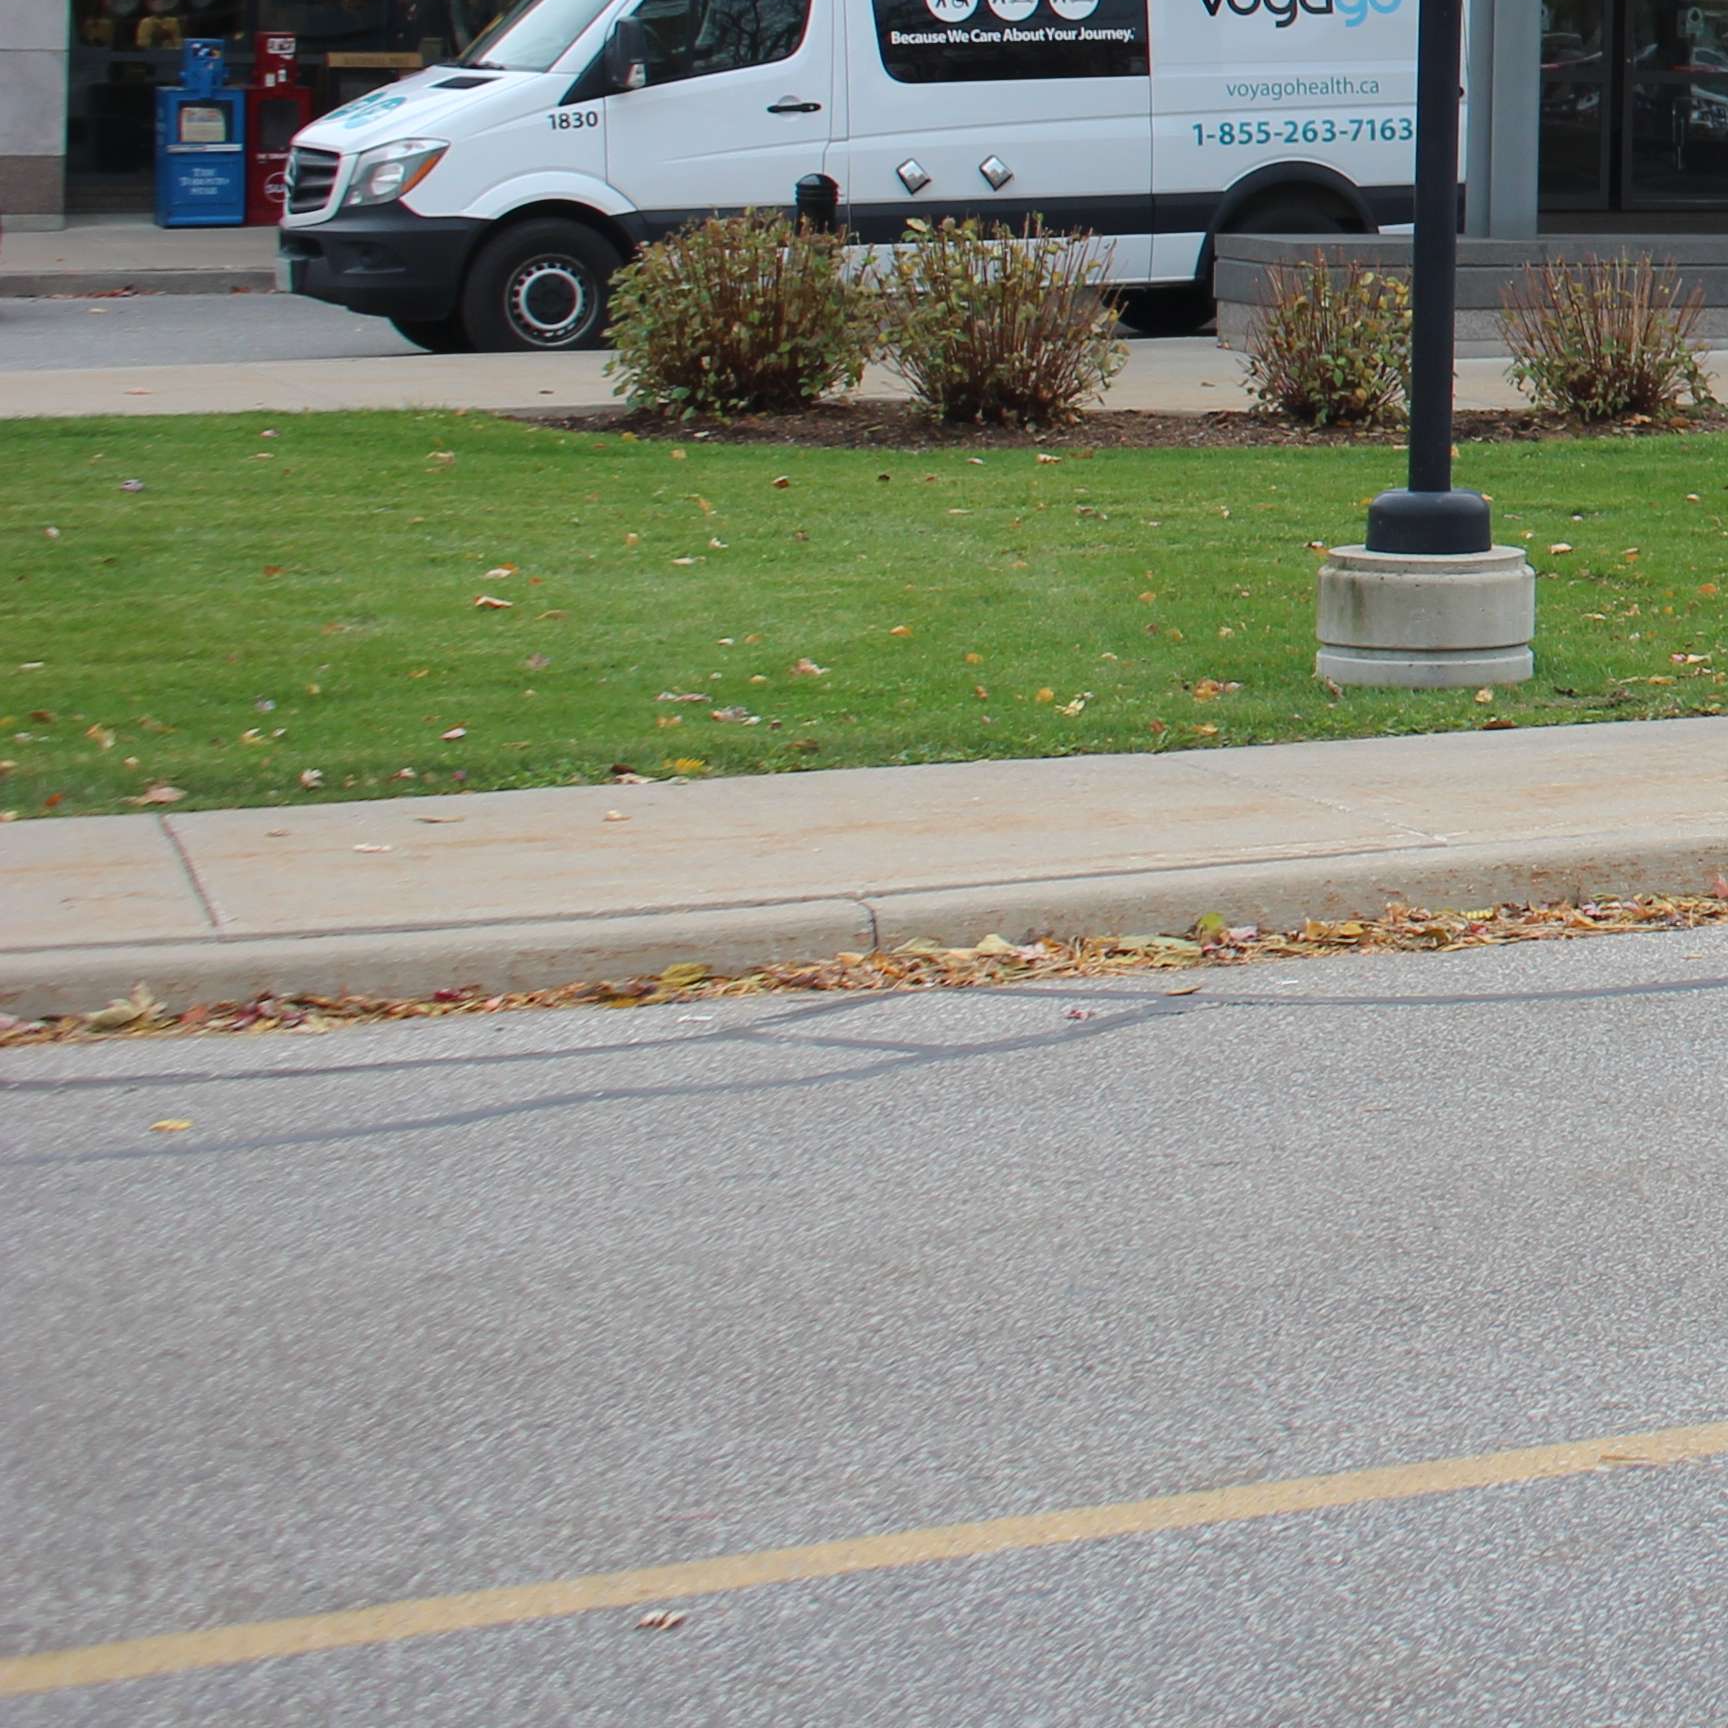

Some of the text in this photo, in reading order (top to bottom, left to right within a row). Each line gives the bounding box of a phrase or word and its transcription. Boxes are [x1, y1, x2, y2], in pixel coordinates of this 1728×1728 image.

[891, 30, 947, 45] Because
[947, 29, 970, 43] We
[970, 29, 1001, 43] Care
[1003, 28, 1045, 42] About
[1047, 27, 1078, 41] Your
[1226, 77, 1380, 101] voyagohealth.ca
[546, 110, 599, 130] 1830
[1192, 118, 1415, 147] 1-855-263-7163
